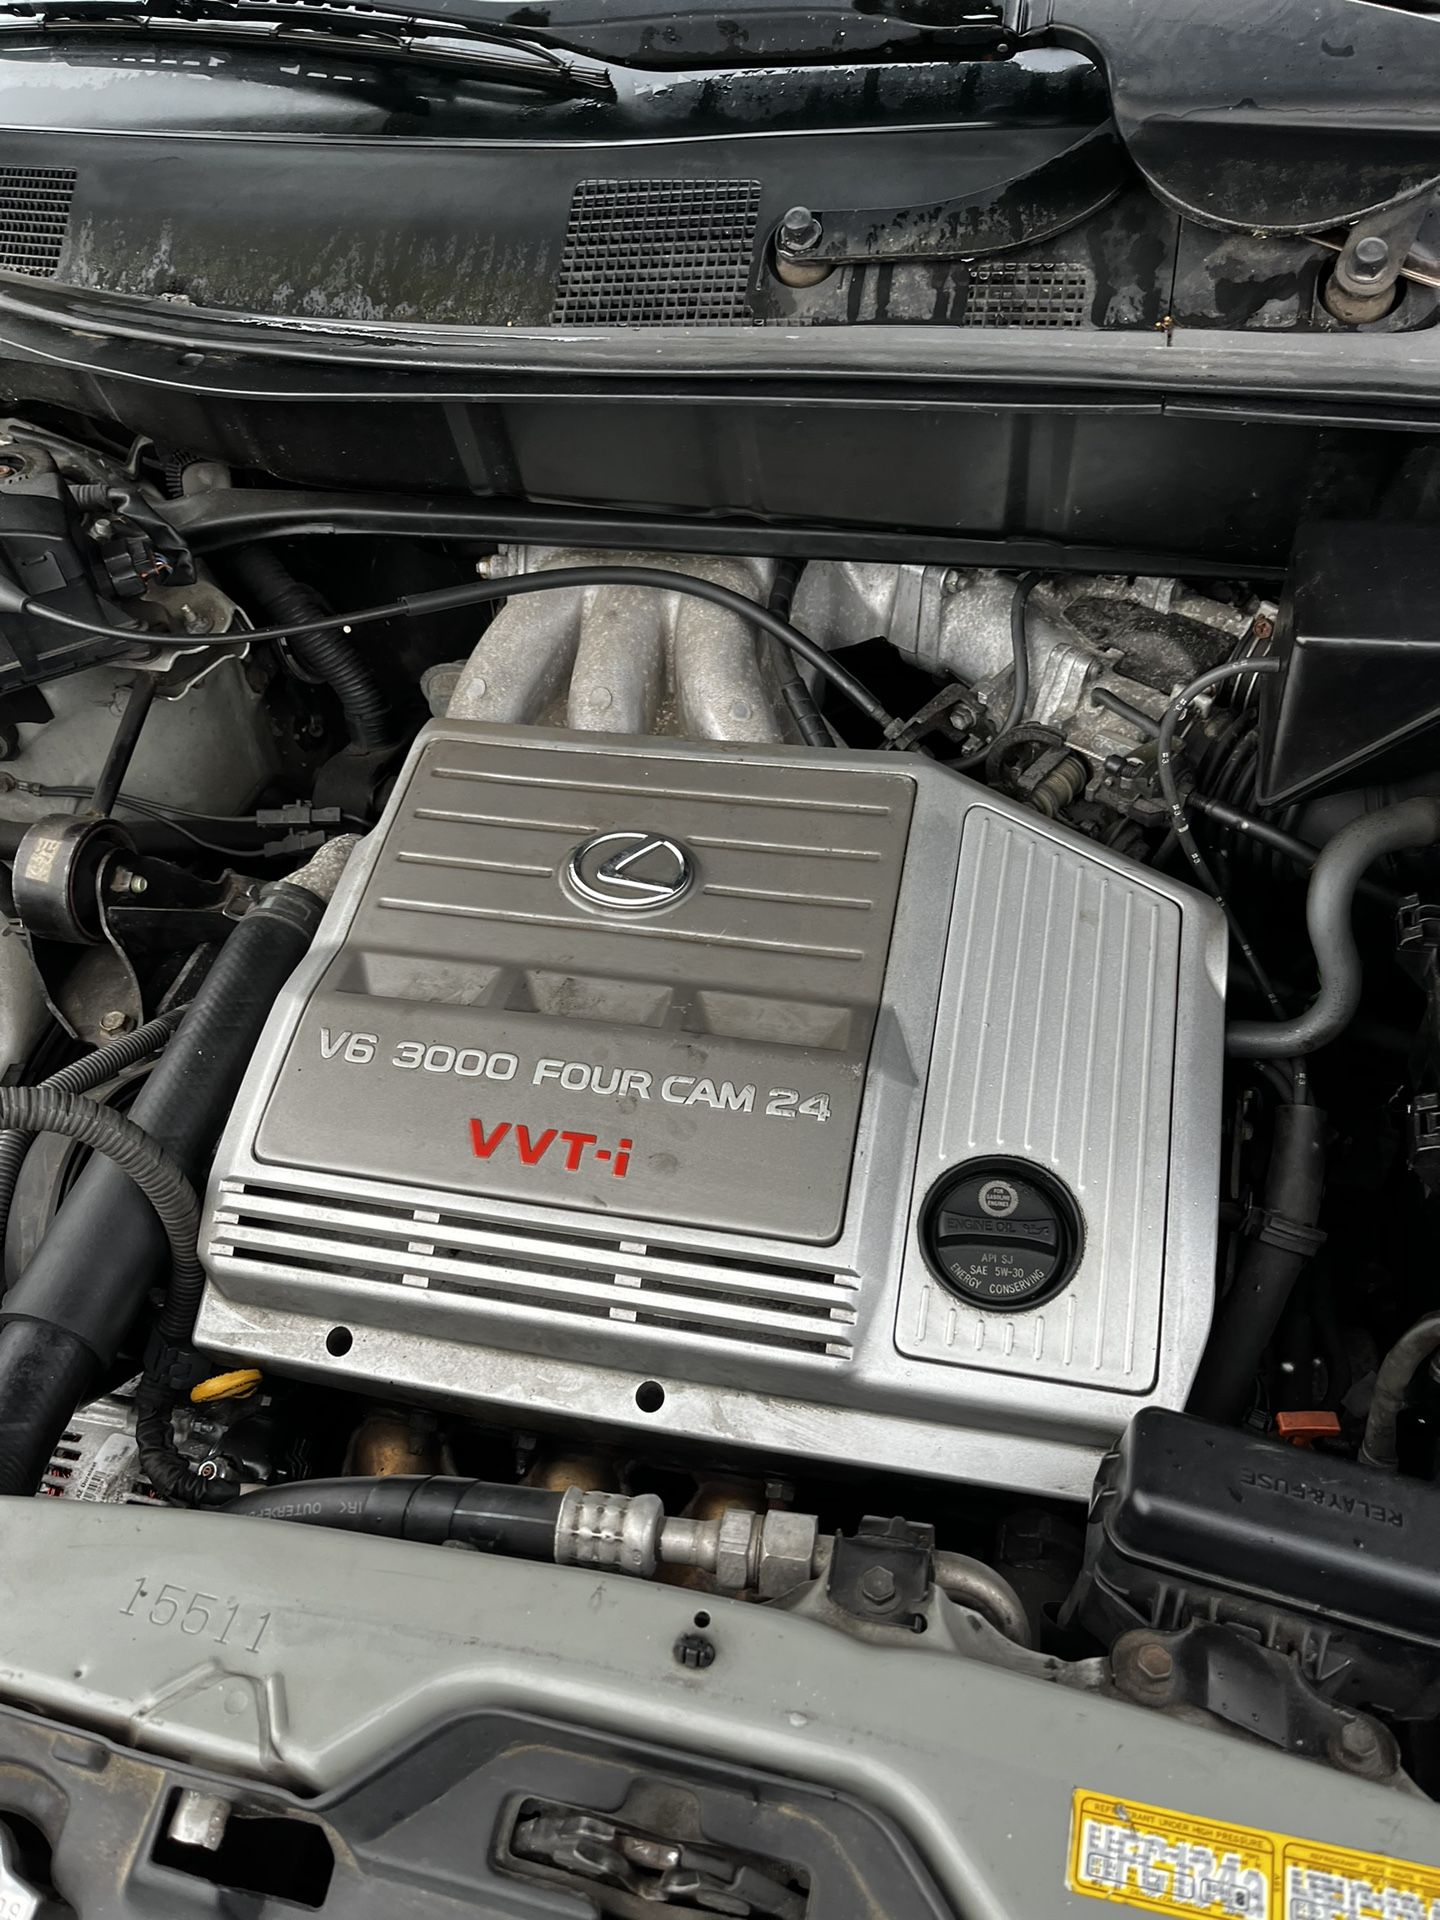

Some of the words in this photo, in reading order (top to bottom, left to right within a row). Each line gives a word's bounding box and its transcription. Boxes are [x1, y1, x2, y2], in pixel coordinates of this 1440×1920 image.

[319, 1027, 378, 1064] V6
[392, 1041, 519, 1081] 3000
[532, 1059, 654, 1099] FOUR
[661, 1075, 757, 1114] CAM
[765, 1088, 832, 1122] 24
[469, 1118, 633, 1178] VVT-i
[947, 1218, 993, 1231] ENGINE
[996, 1221, 1016, 1232] OIL
[950, 1262, 982, 1289] ENERGY
[989, 1268, 1045, 1294] CONSERVING
[970, 1264, 988, 1275] SAE
[995, 1266, 1024, 1278] 5W-30
[981, 1253, 997, 1263] API
[1001, 1254, 1014, 1264] SJ
[1240, 1467, 1403, 1527] RELAY&FUSE
[119, 1577, 272, 1654] 15511
